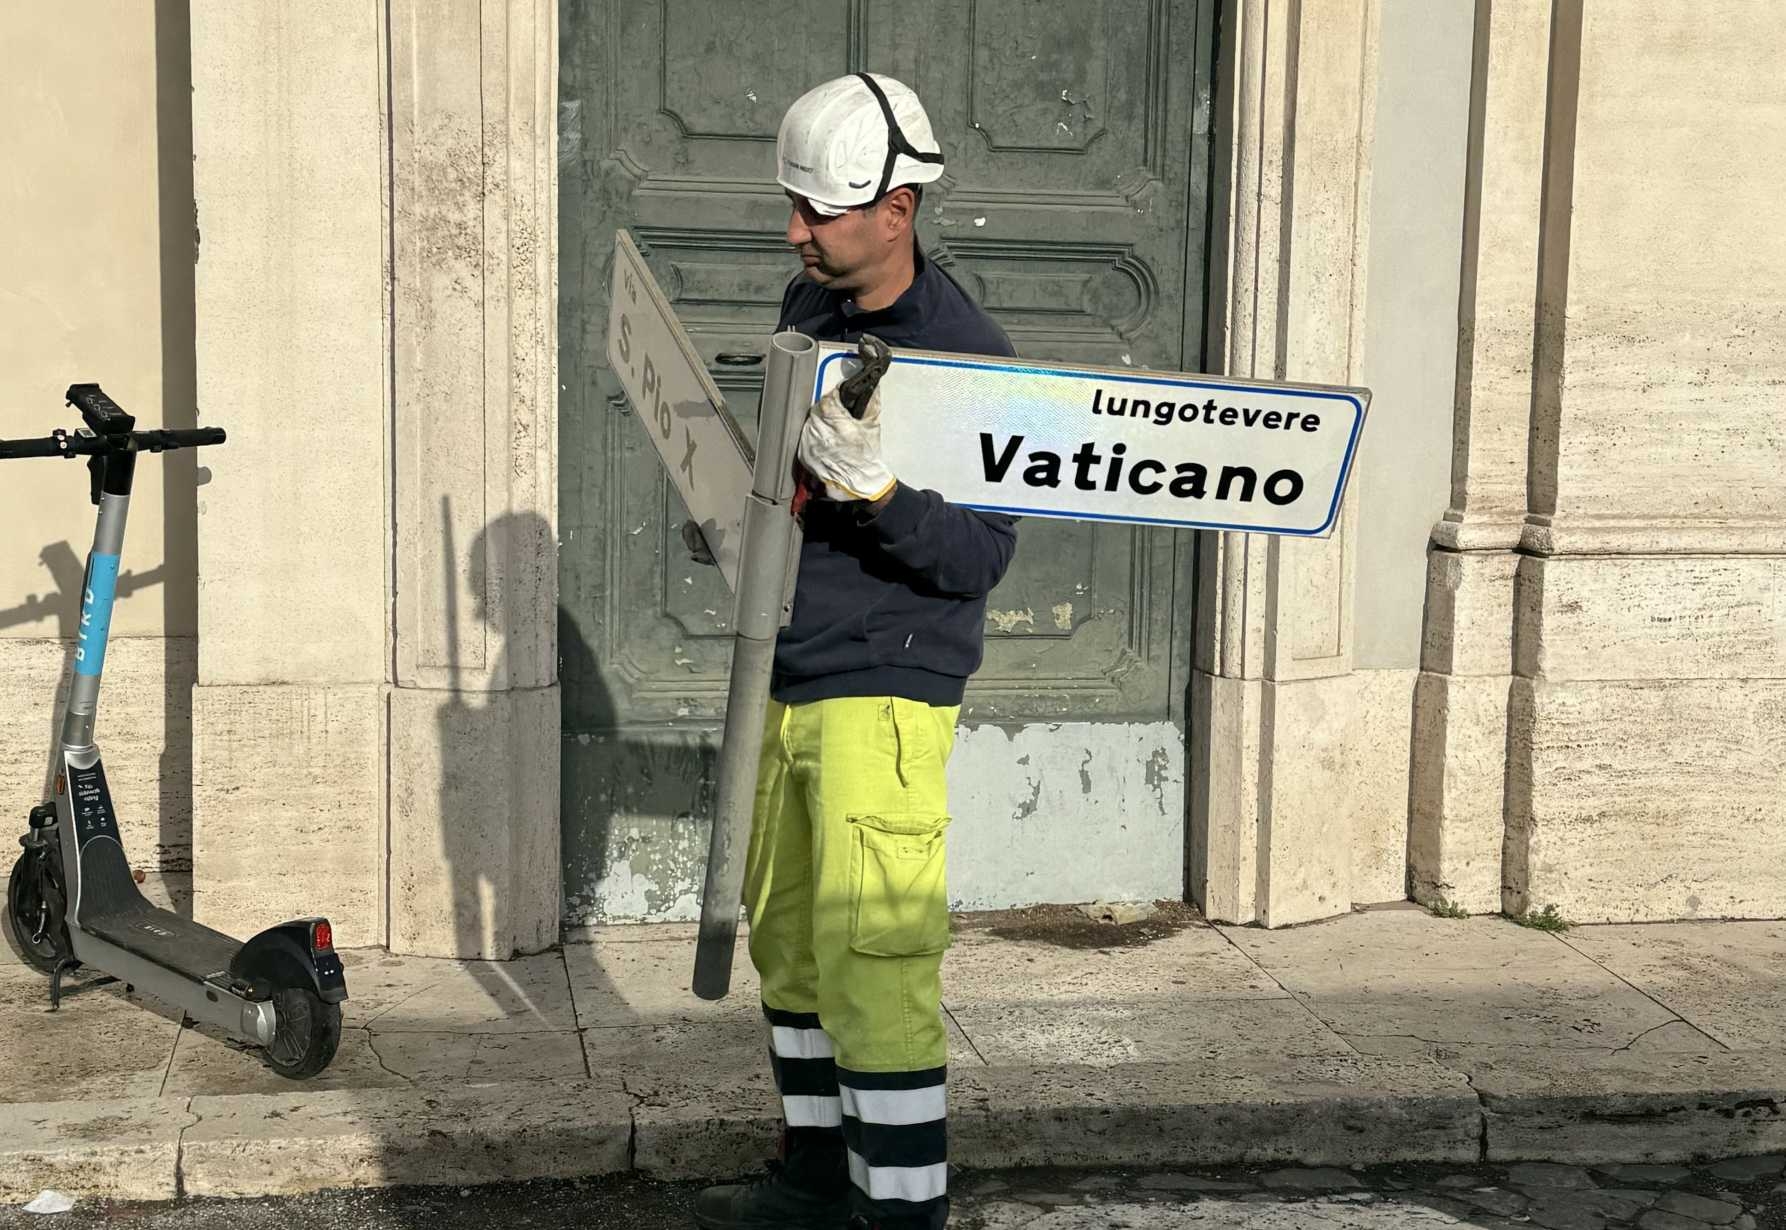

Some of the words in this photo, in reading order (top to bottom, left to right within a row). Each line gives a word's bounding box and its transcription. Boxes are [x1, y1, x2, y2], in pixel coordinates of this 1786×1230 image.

[618, 314, 635, 378] S.
[642, 353, 671, 440] Pio
[680, 425, 697, 490] X
[1092, 389, 1321, 432] lungotevere
[979, 433, 1304, 506] Vaticano
